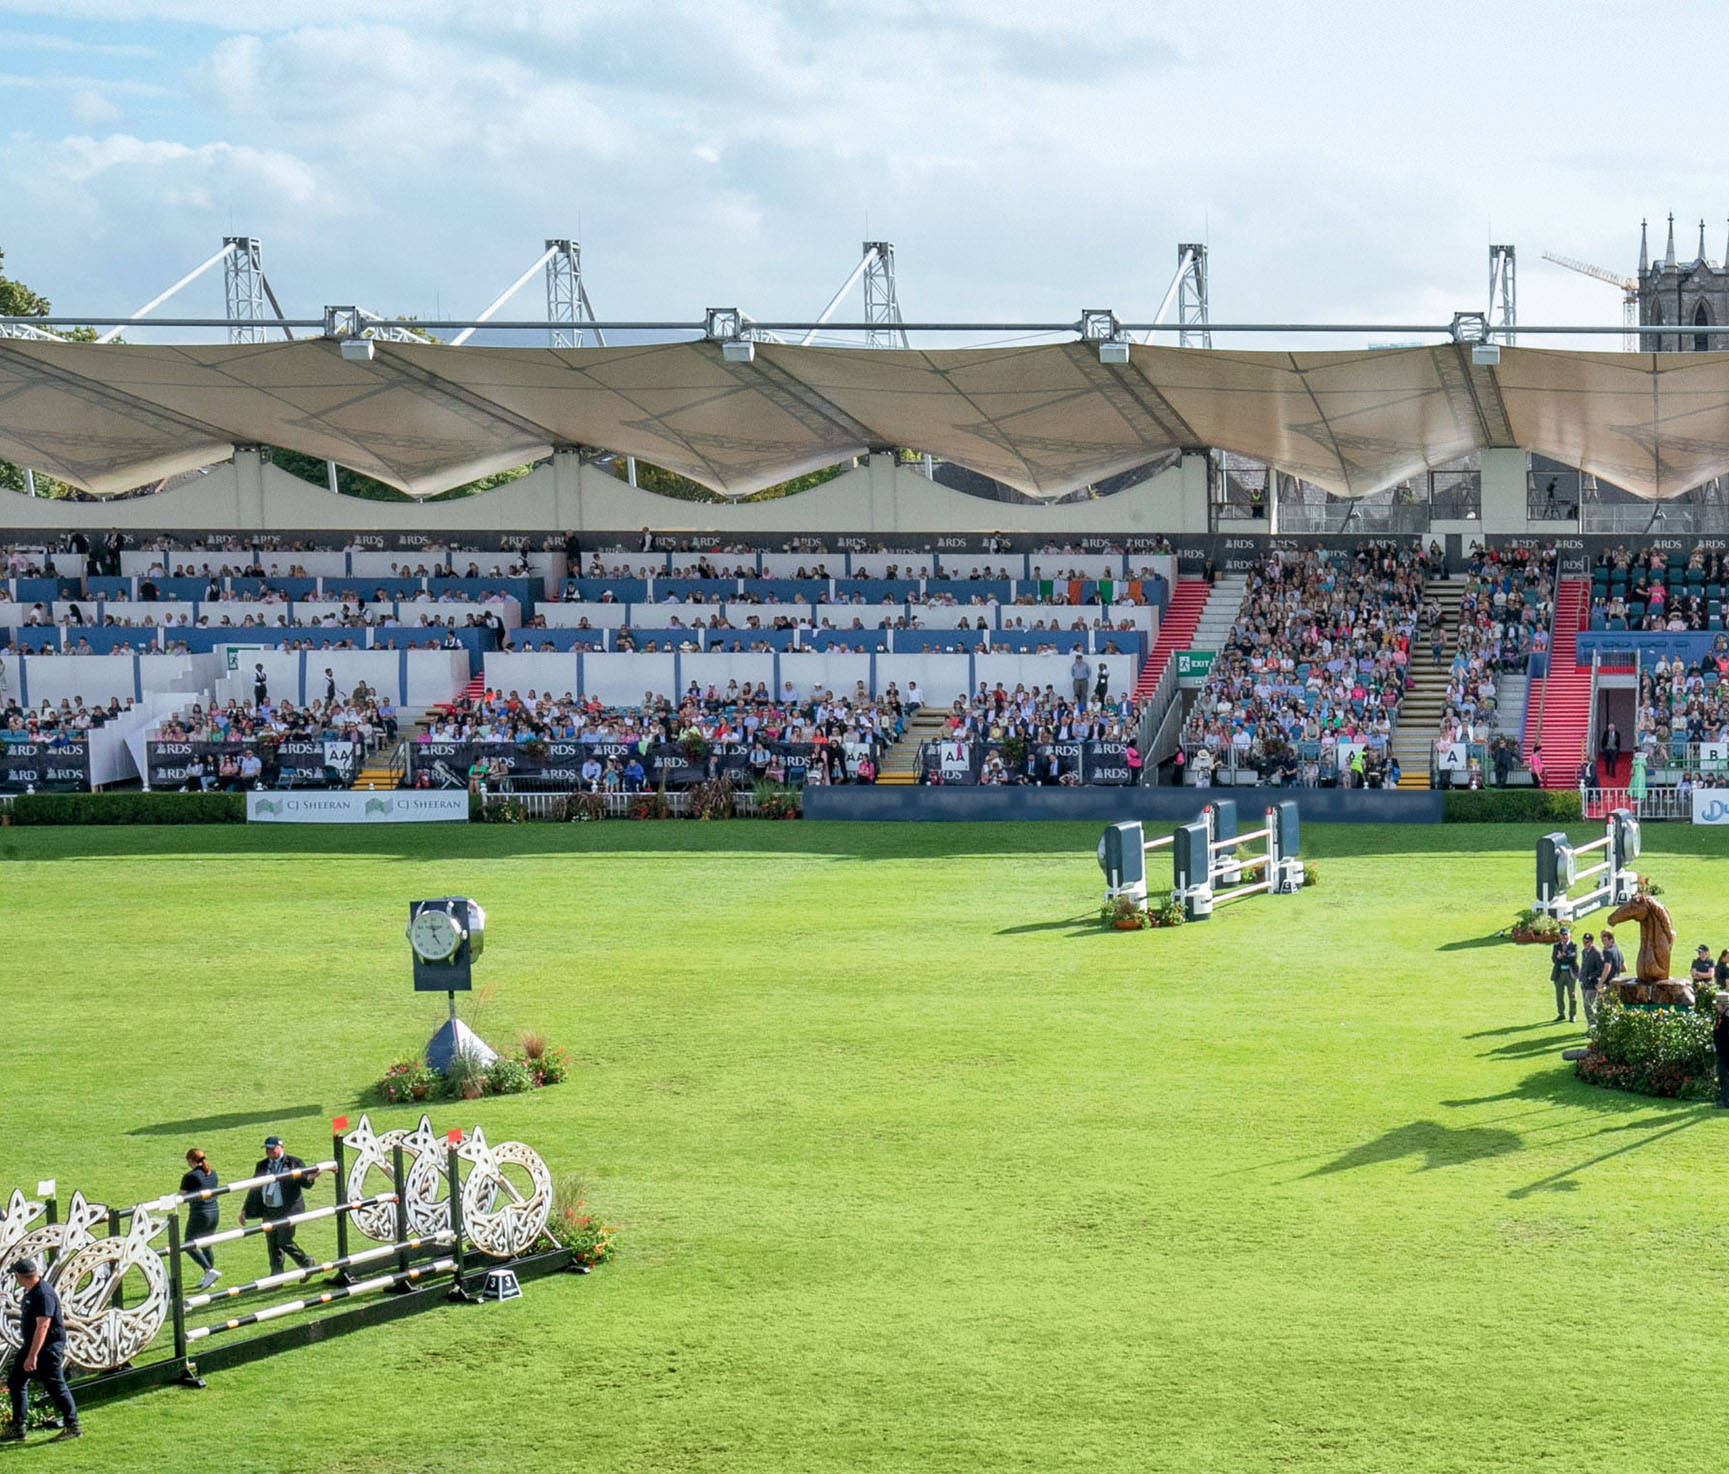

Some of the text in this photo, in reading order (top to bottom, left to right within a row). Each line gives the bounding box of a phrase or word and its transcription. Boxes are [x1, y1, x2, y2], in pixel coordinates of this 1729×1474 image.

[362, 536, 383, 544] RDS
[407, 536, 428, 544] RDS
[700, 537, 720, 545] RDS
[846, 538, 866, 546] RDS
[946, 538, 966, 546] RDS
[1090, 539, 1110, 548] RDS
[1135, 539, 1155, 548] RDS
[1234, 540, 1254, 548] RDS
[1431, 540, 1438, 548] A
[1469, 540, 1477, 550] A
[1563, 540, 1583, 548] RDS
[1661, 540, 1681, 548] RDS
[1706, 540, 1726, 548] RDS
[1184, 550, 1204, 558] RDS
[1563, 560, 1583, 569] RDS
[167, 744, 192, 754] RDS
[289, 744, 313, 754] RDS
[430, 744, 455, 755] RDS
[551, 745, 575, 755] RDS
[604, 745, 628, 755] RDS
[1055, 746, 1079, 756] RDS
[1103, 744, 1128, 754] RDS
[330, 750, 348, 760] AA
[946, 752, 965, 762] AA
[1447, 751, 1458, 762] A
[1710, 750, 1718, 761] B
[664, 757, 689, 768] RDS
[787, 757, 811, 767] RDS
[58, 768, 83, 779] RDS
[296, 768, 313, 778] DS
[551, 768, 575, 779] RDS
[1104, 768, 1128, 779] RDS
[288, 800, 350, 810] CJ SHEERAN
[398, 800, 461, 810] CJ SHEERAN
[490, 1277, 496, 1288] 3
[505, 1276, 512, 1287] 3
